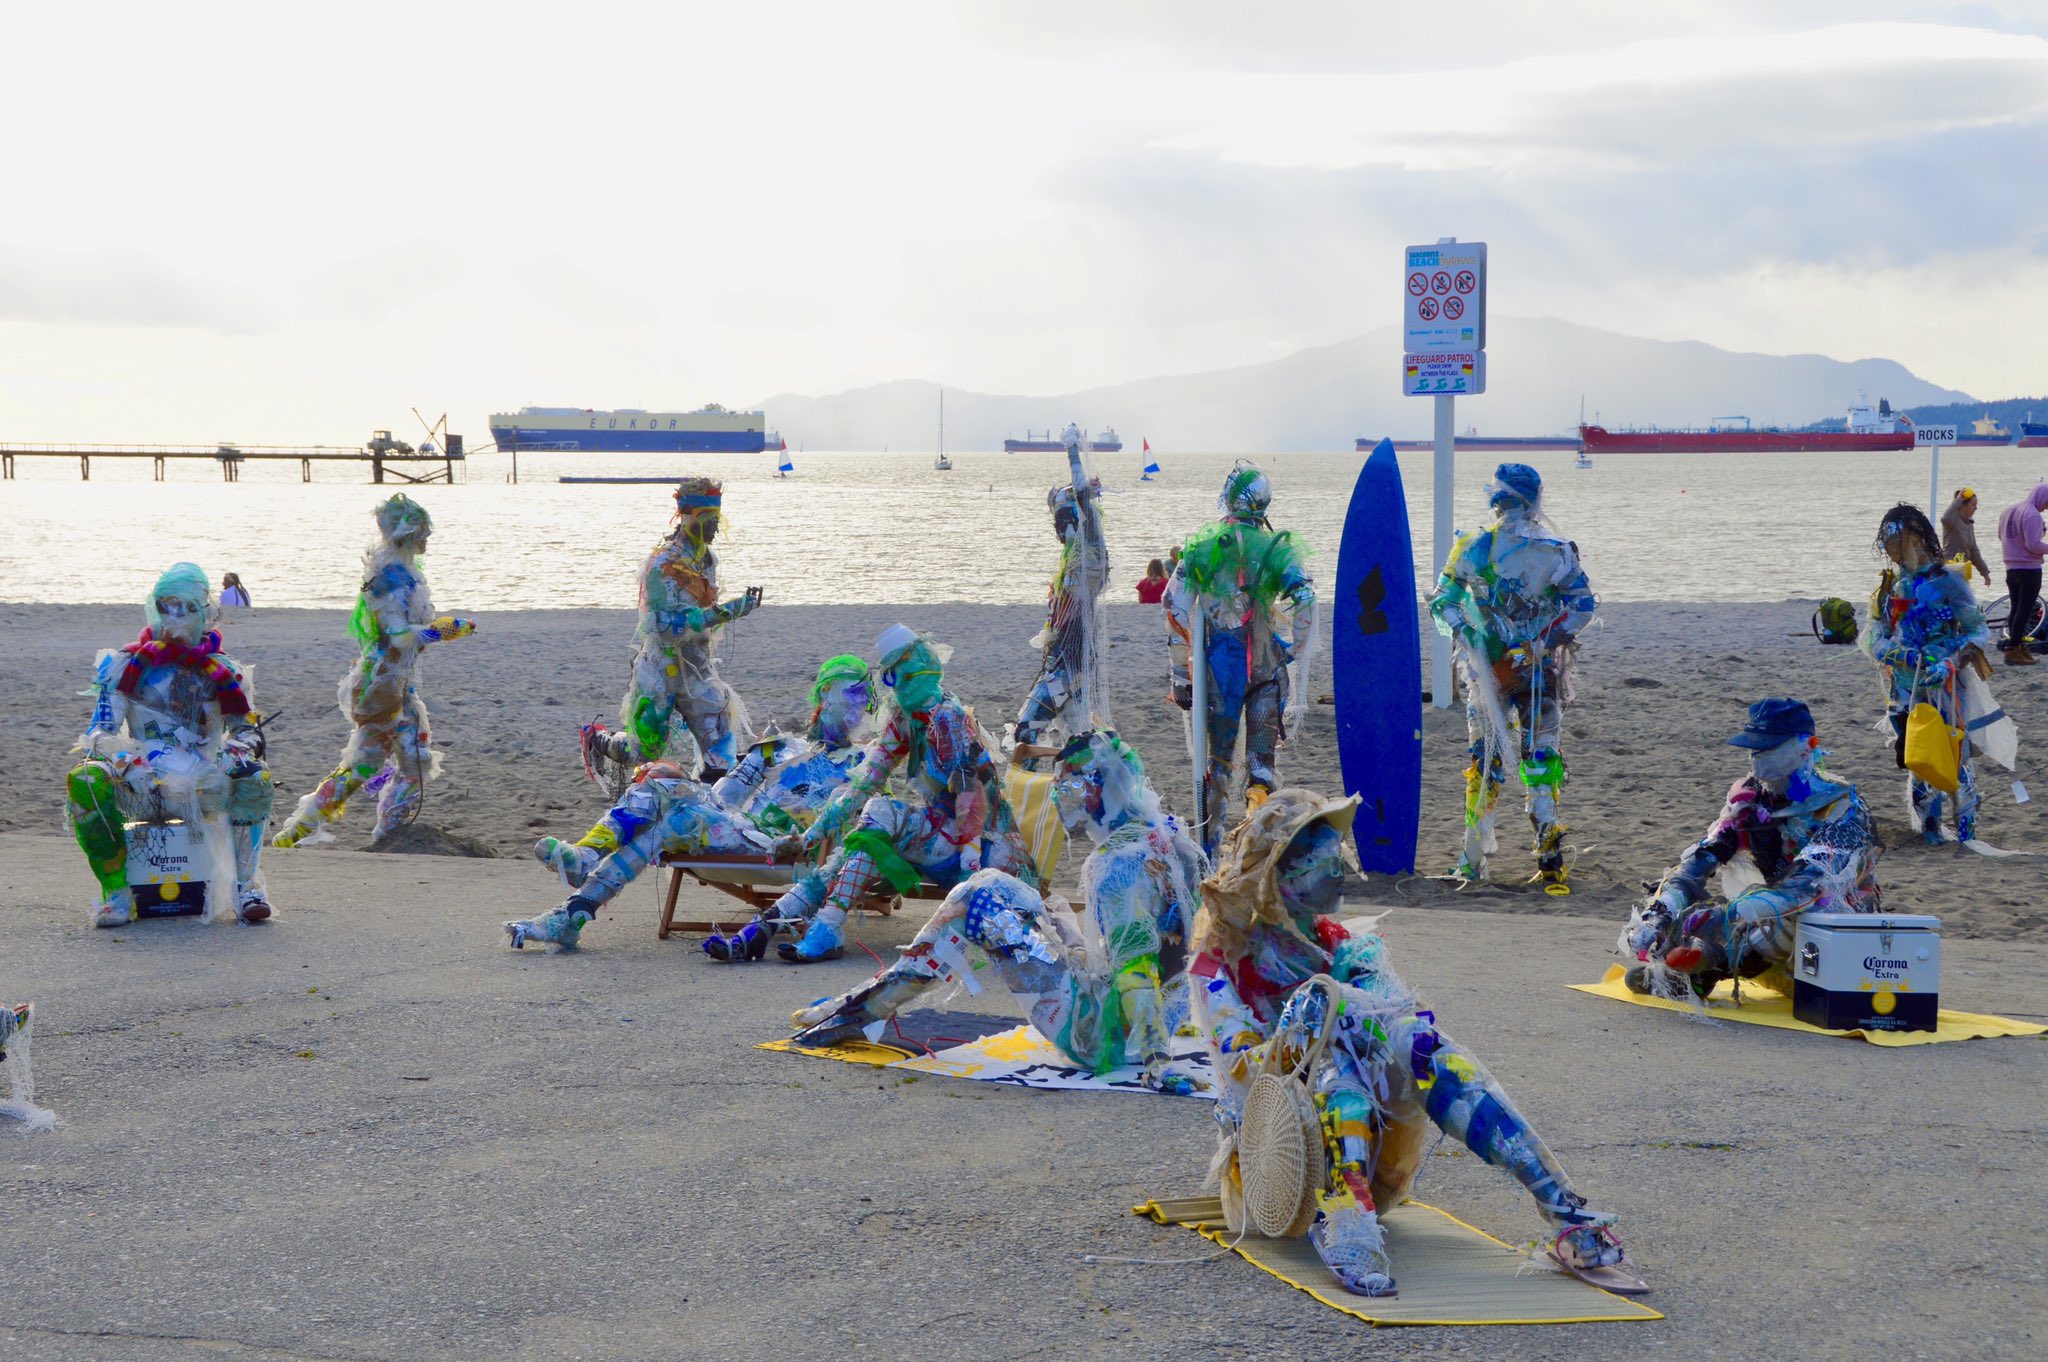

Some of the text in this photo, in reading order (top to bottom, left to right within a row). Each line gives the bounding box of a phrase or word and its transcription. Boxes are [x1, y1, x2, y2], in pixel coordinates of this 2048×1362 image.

[1408, 255, 1477, 268] BEACH bylaws
[1406, 353, 1475, 364] LIFEGUARD PATROL
[590, 417, 677, 430] EUKOR
[1918, 430, 1954, 440] ROCKS
[150, 855, 188, 866] Corona
[1863, 956, 1909, 971] Corona
[1875, 969, 1899, 979] Extra
